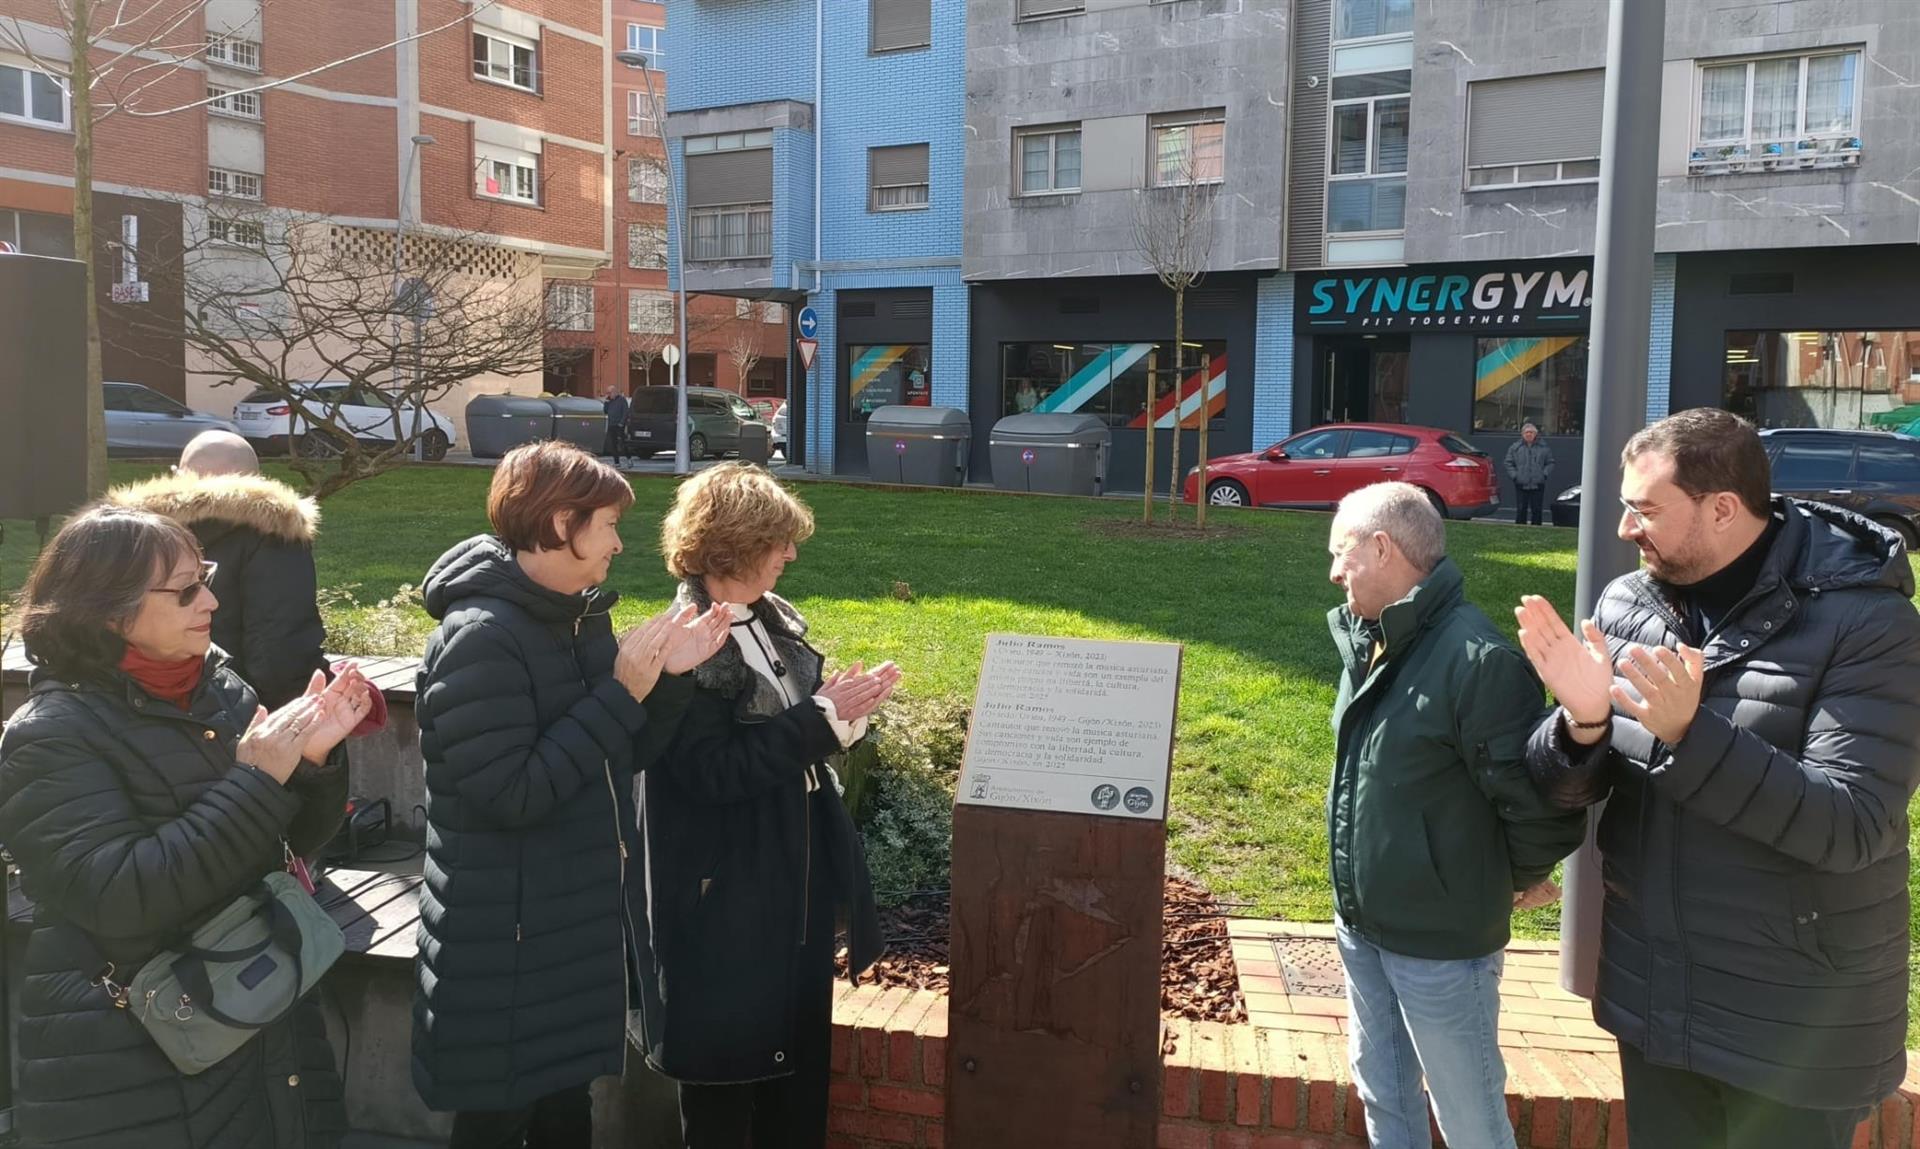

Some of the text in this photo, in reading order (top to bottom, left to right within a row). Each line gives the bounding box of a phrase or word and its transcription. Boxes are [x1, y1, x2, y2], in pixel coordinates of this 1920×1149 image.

[1308, 270, 1589, 314] SYNERGYM
[1362, 314, 1521, 326] FIT TOGETHER
[995, 639, 1065, 650] Julio Ramos
[983, 702, 1054, 713] Julio Ramos
[1083, 738, 1117, 747] ejemplo
[1119, 739, 1129, 747] de
[1030, 743, 1046, 751] con
[1047, 743, 1056, 751] la
[1098, 747, 1107, 755] la
[1044, 752, 1052, 760] la
